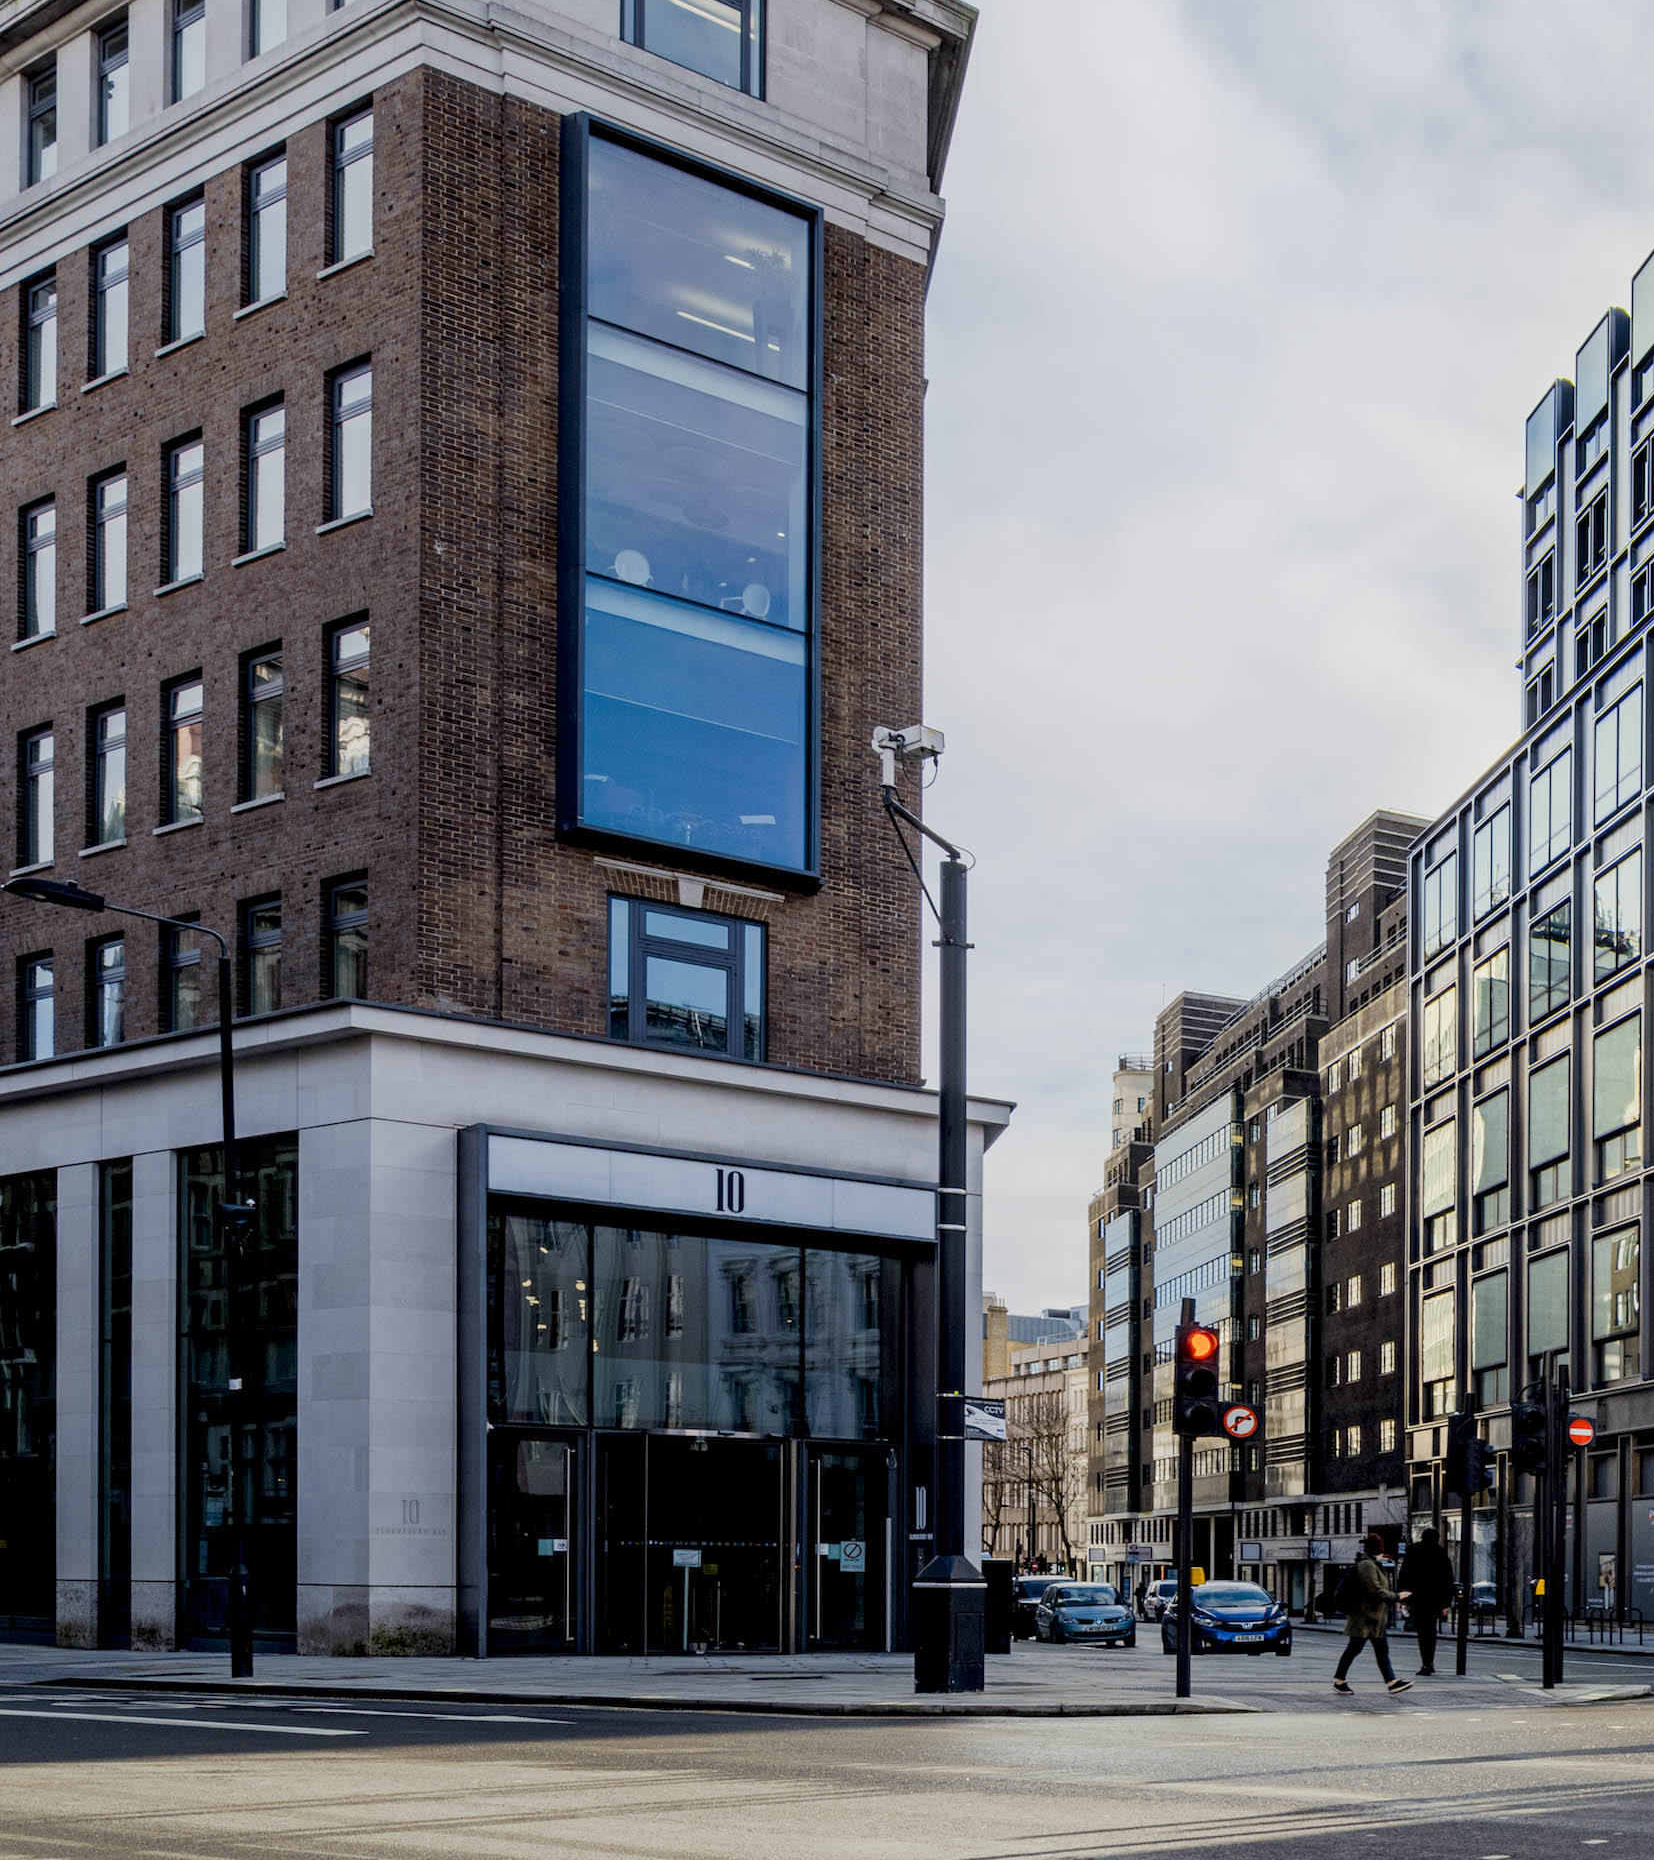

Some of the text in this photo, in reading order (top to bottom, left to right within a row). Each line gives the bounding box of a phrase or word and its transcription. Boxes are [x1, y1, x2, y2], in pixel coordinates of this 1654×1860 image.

[715, 1168, 745, 1213] 10
[984, 1406, 1004, 1414] CCTV
[402, 1499, 420, 1525] 10
[916, 1486, 927, 1530] 10
